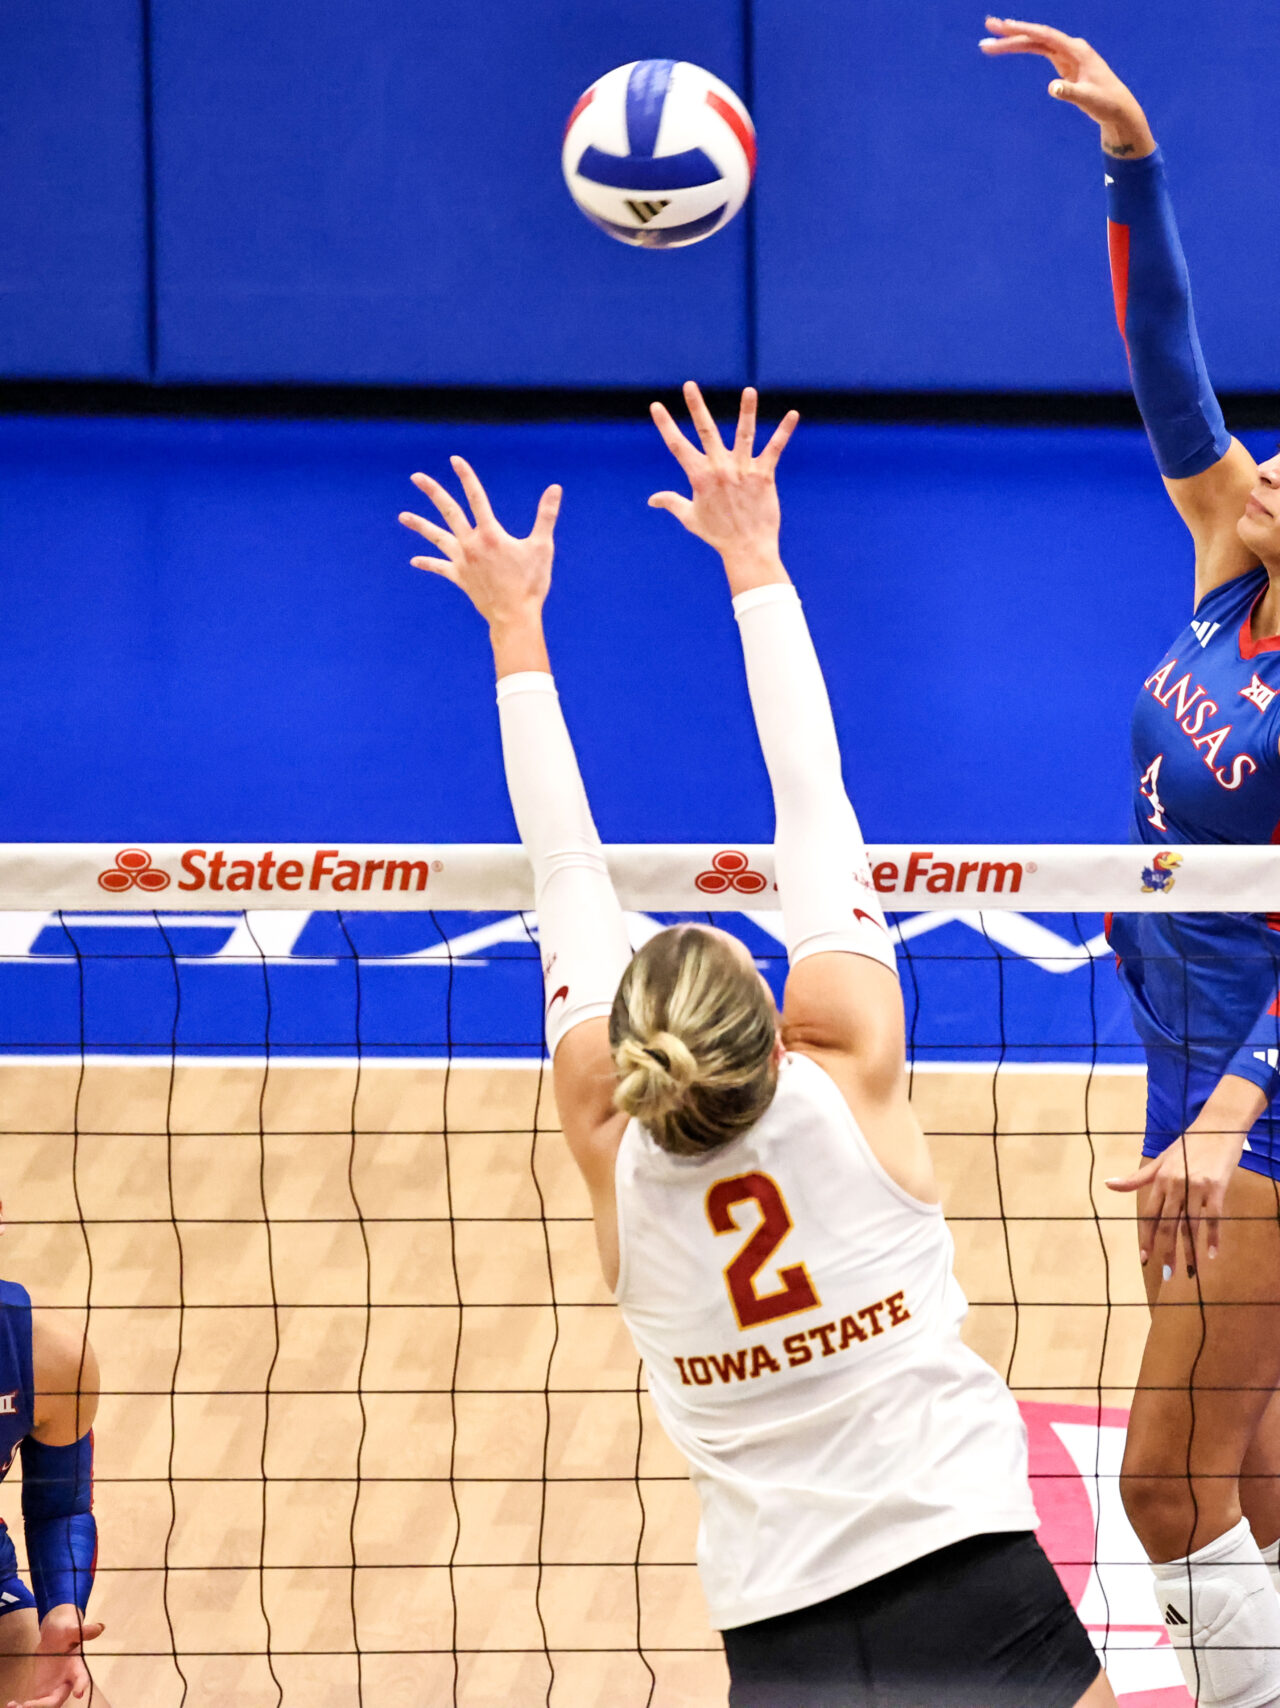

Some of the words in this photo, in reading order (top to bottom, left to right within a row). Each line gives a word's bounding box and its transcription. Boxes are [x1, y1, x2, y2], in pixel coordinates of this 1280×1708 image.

[1143, 658, 1258, 791] ANSAS
[704, 1169, 822, 1332] 2
[673, 1344, 781, 1387] IOWA
[783, 1289, 912, 1369] STATE
